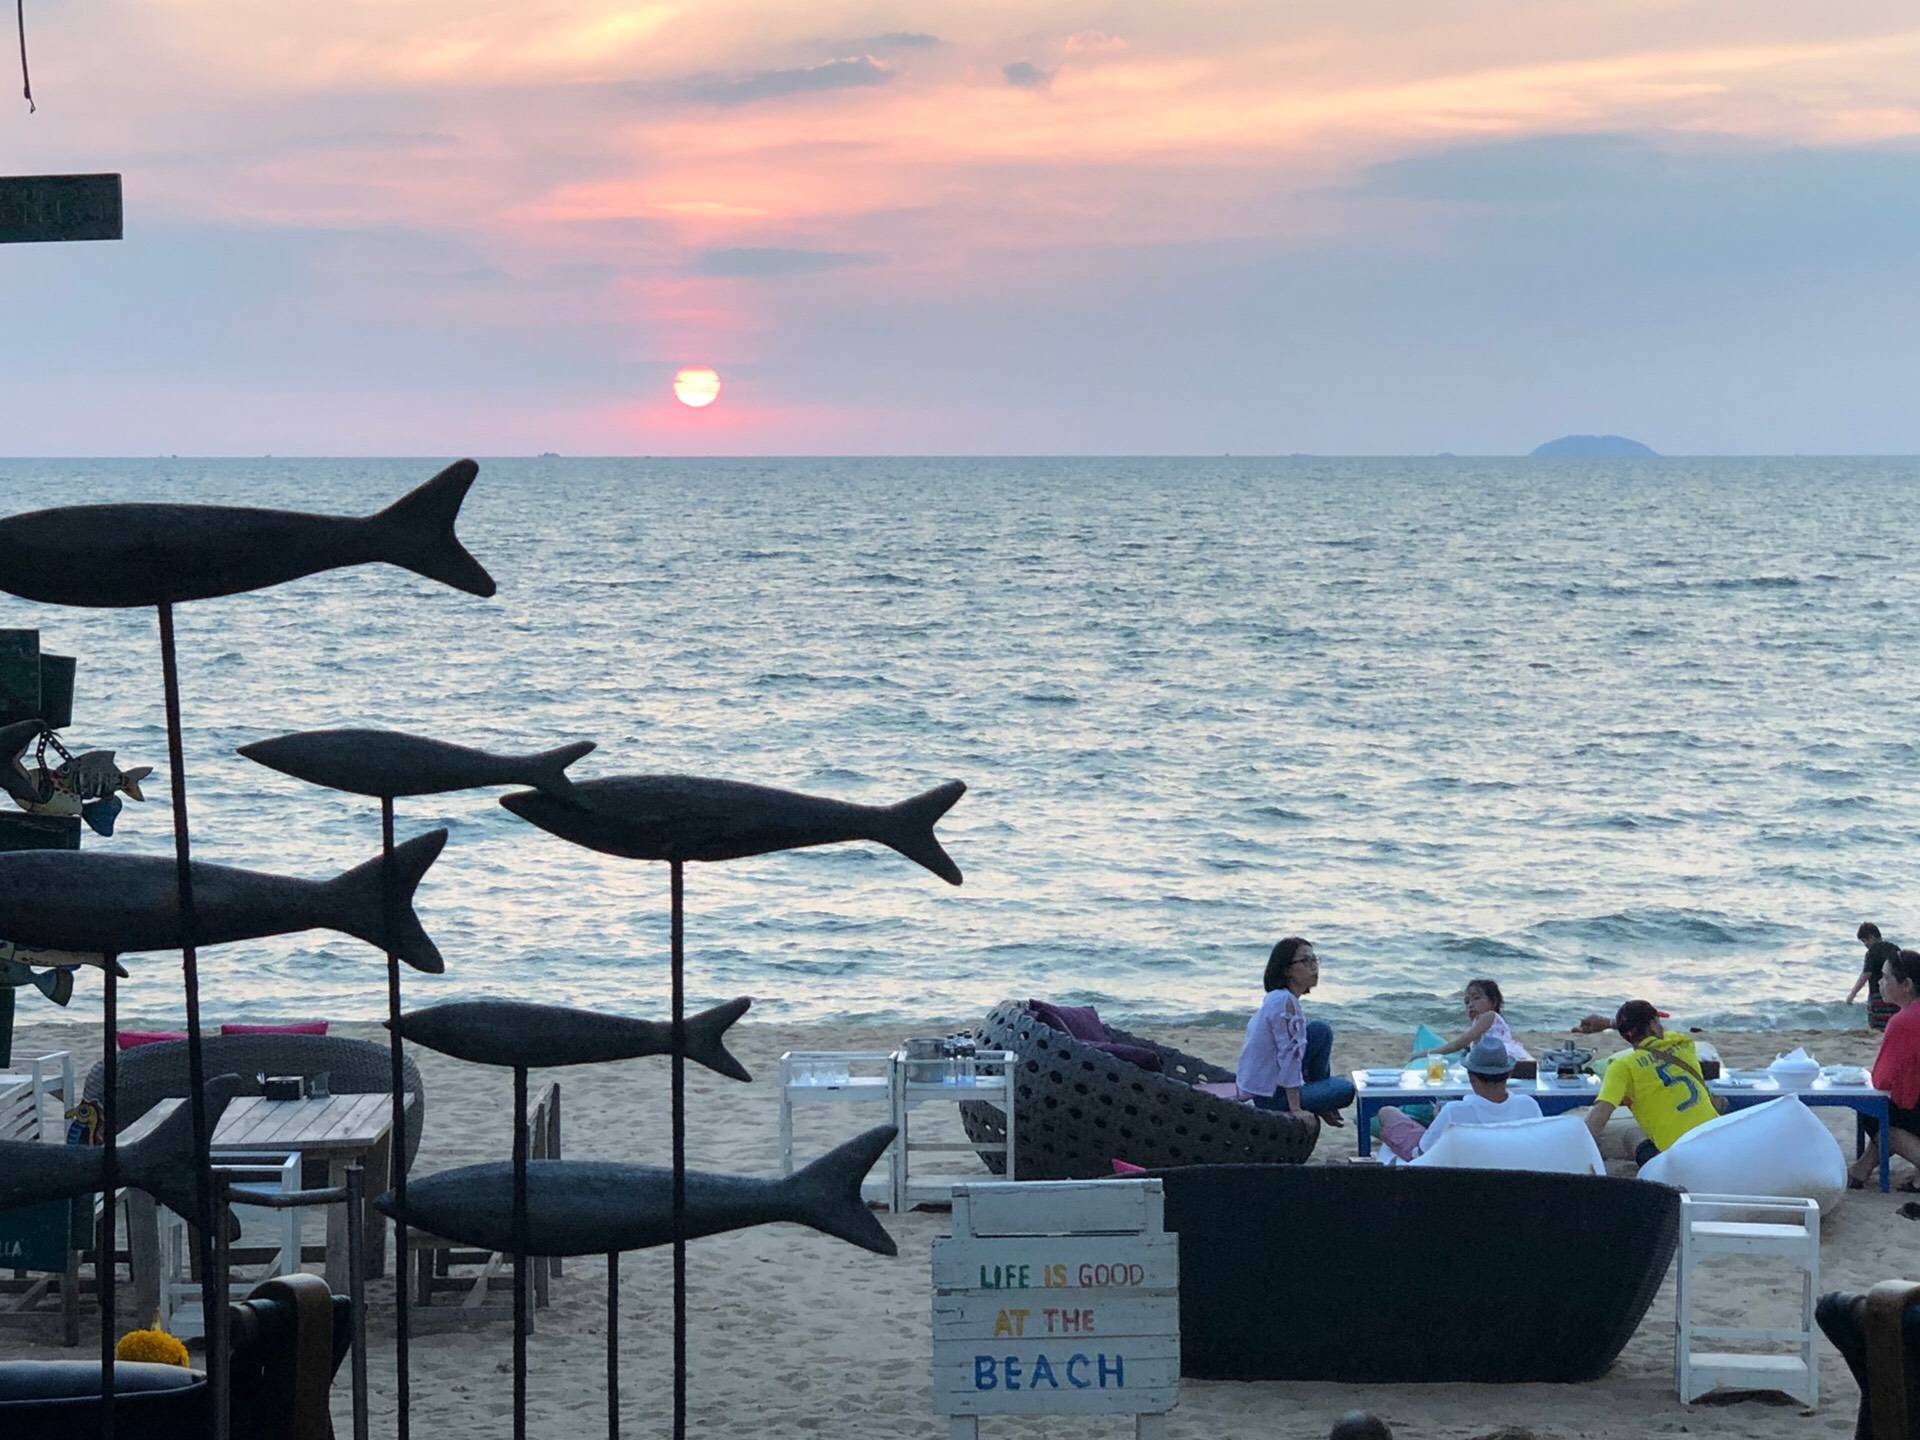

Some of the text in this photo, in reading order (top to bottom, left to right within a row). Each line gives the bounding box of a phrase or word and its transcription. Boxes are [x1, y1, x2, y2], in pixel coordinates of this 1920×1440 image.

[1655, 1062, 1700, 1111] 5
[980, 1263, 1145, 1289] LIFE IS GOOD
[992, 1308, 1095, 1337] AT THE
[974, 1353, 1125, 1390] BEACH
